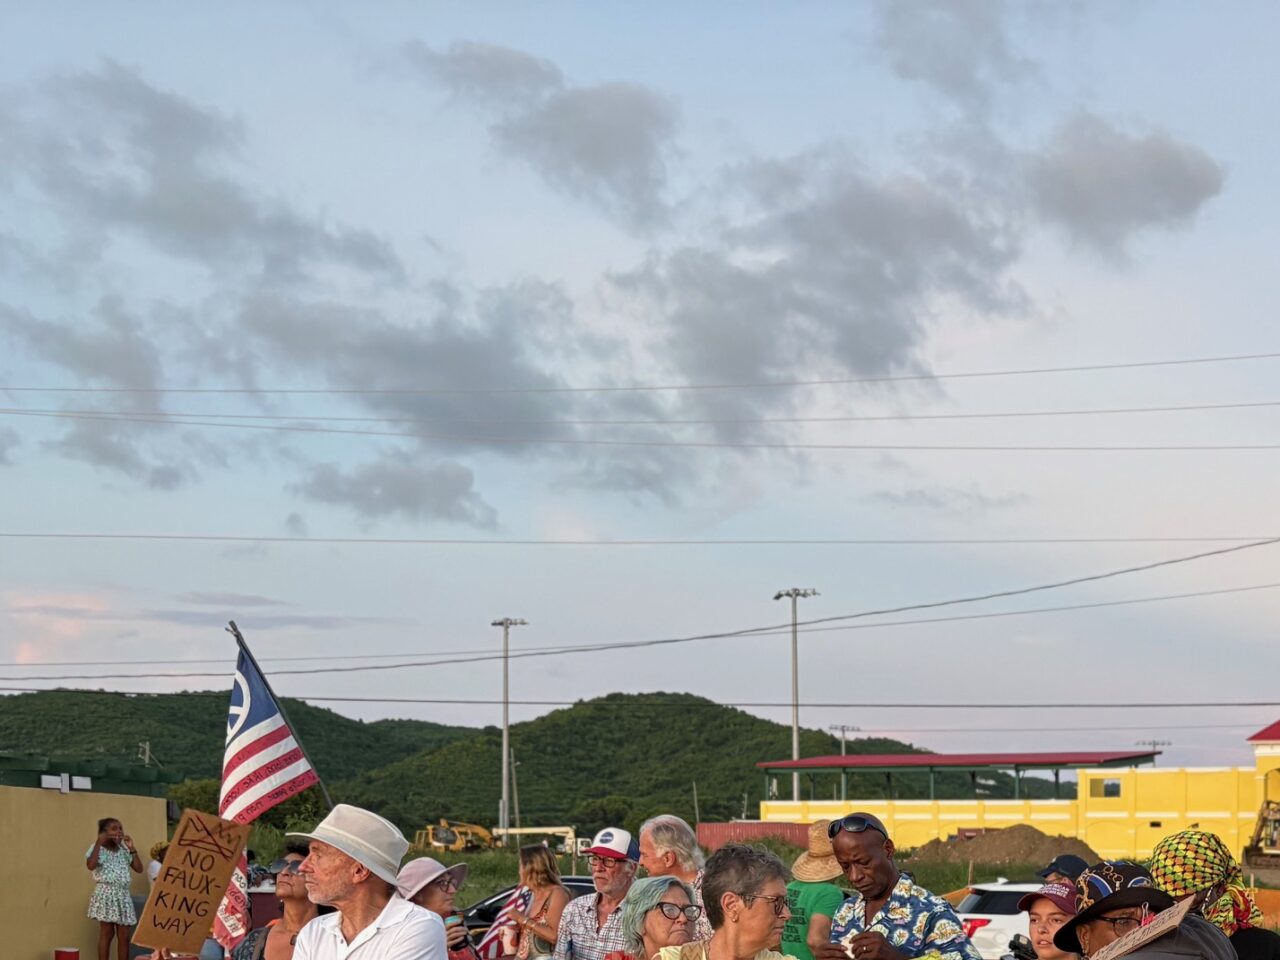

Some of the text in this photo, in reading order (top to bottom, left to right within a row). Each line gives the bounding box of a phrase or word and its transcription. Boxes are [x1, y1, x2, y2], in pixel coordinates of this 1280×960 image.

[182, 850, 215, 872] NO
[164, 866, 222, 895] FAUX-
[155, 890, 210, 918] KING
[153, 915, 194, 936] WAY
